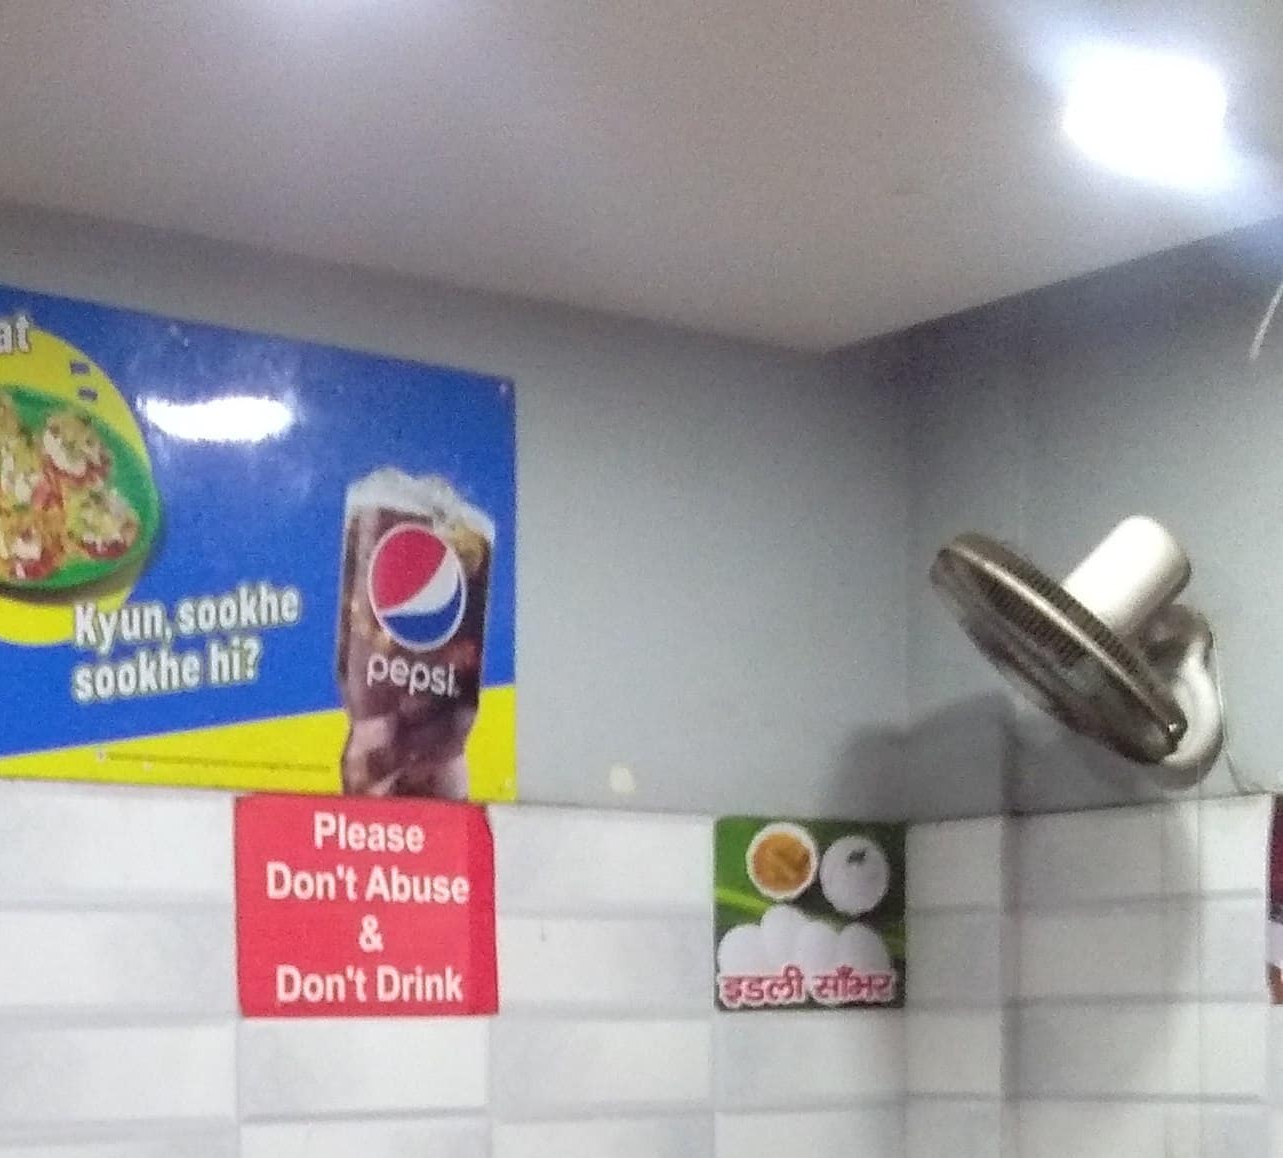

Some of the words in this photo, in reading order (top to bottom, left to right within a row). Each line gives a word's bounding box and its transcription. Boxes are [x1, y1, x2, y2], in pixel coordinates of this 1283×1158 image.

[176, 582, 301, 636] sookhe
[74, 649, 202, 703] sookhe
[209, 636, 262, 686] hi?
[366, 653, 455, 698] pepsi
[314, 811, 425, 853] Please
[267, 862, 358, 901] Don't
[366, 866, 471, 904] Abuse
[358, 914, 384, 952] &
[276, 965, 366, 1003] Don't
[377, 966, 464, 1003] Drink
[722, 965, 804, 1004] इडली
